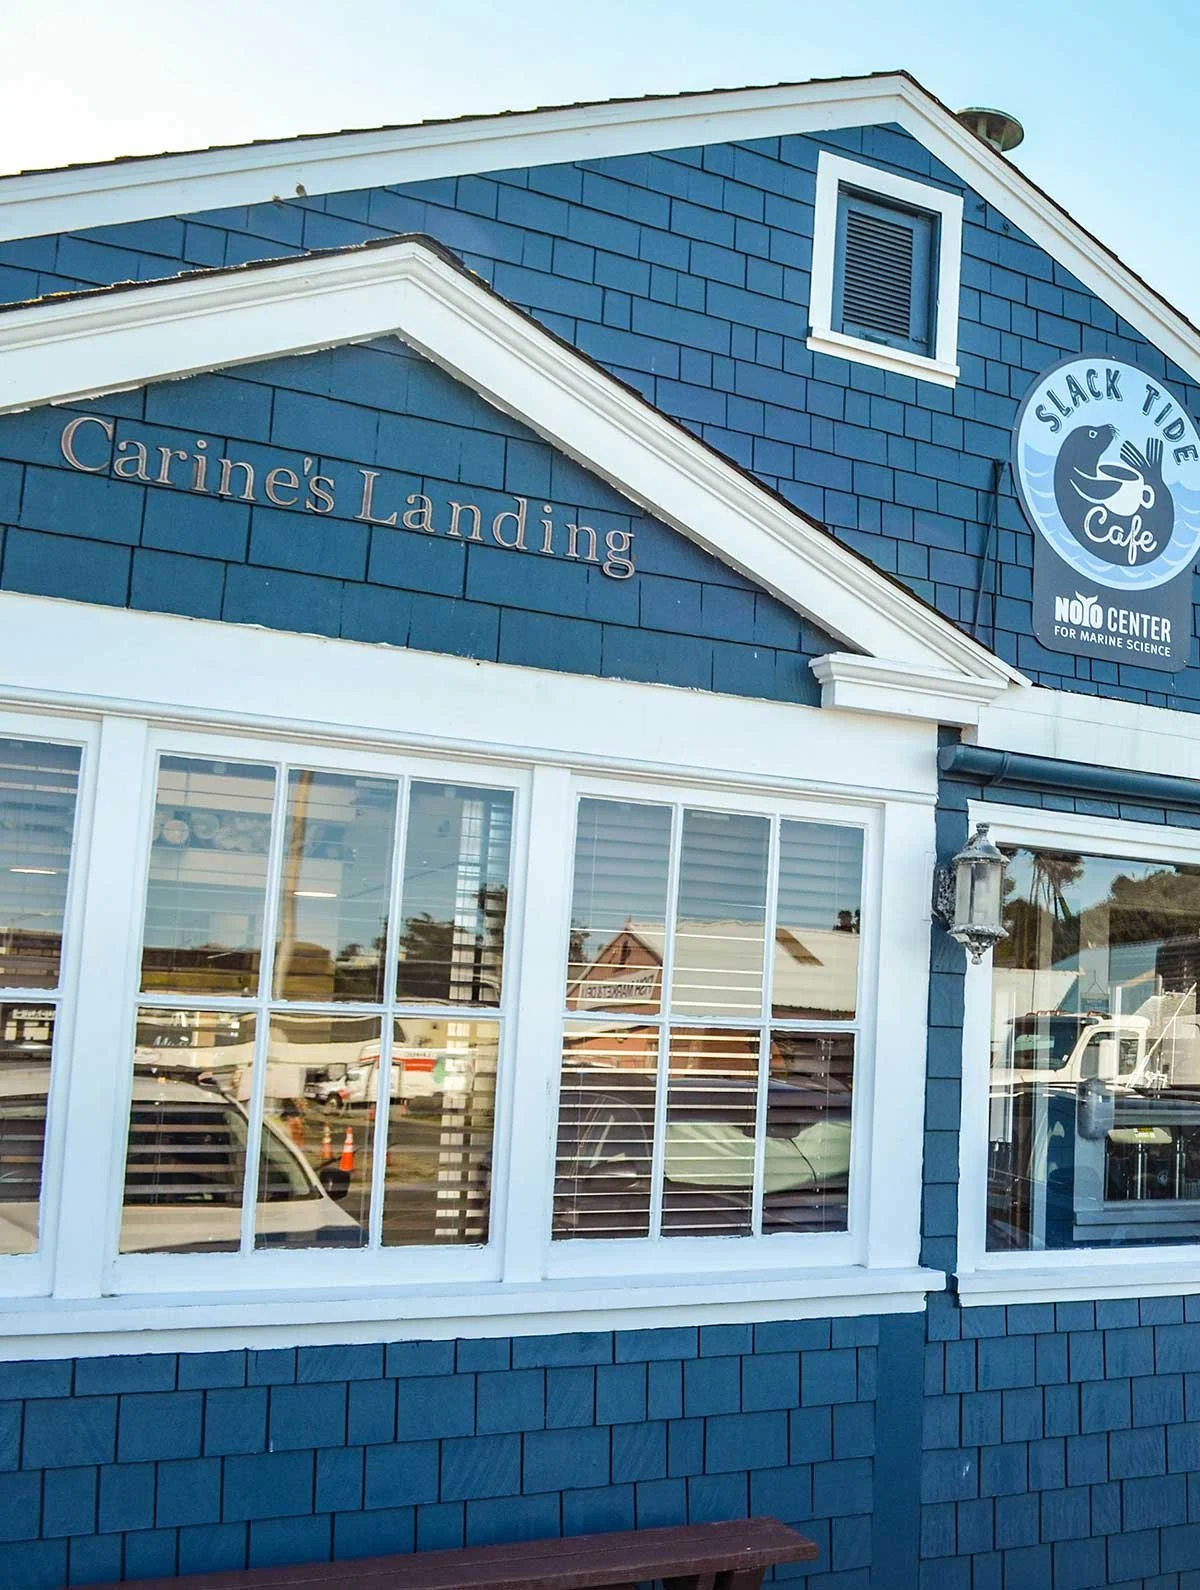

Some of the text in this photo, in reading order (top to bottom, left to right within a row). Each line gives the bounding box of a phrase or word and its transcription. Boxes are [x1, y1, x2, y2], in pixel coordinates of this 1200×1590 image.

[1035, 368, 1199, 466] SLACK TIDE
[59, 416, 636, 579] Carine's Landing
[1084, 506, 1158, 565] Cafe
[1054, 625, 1171, 657] FOR MARINE SCIENCE
[1055, 591, 1171, 643] NOYO CENTER
